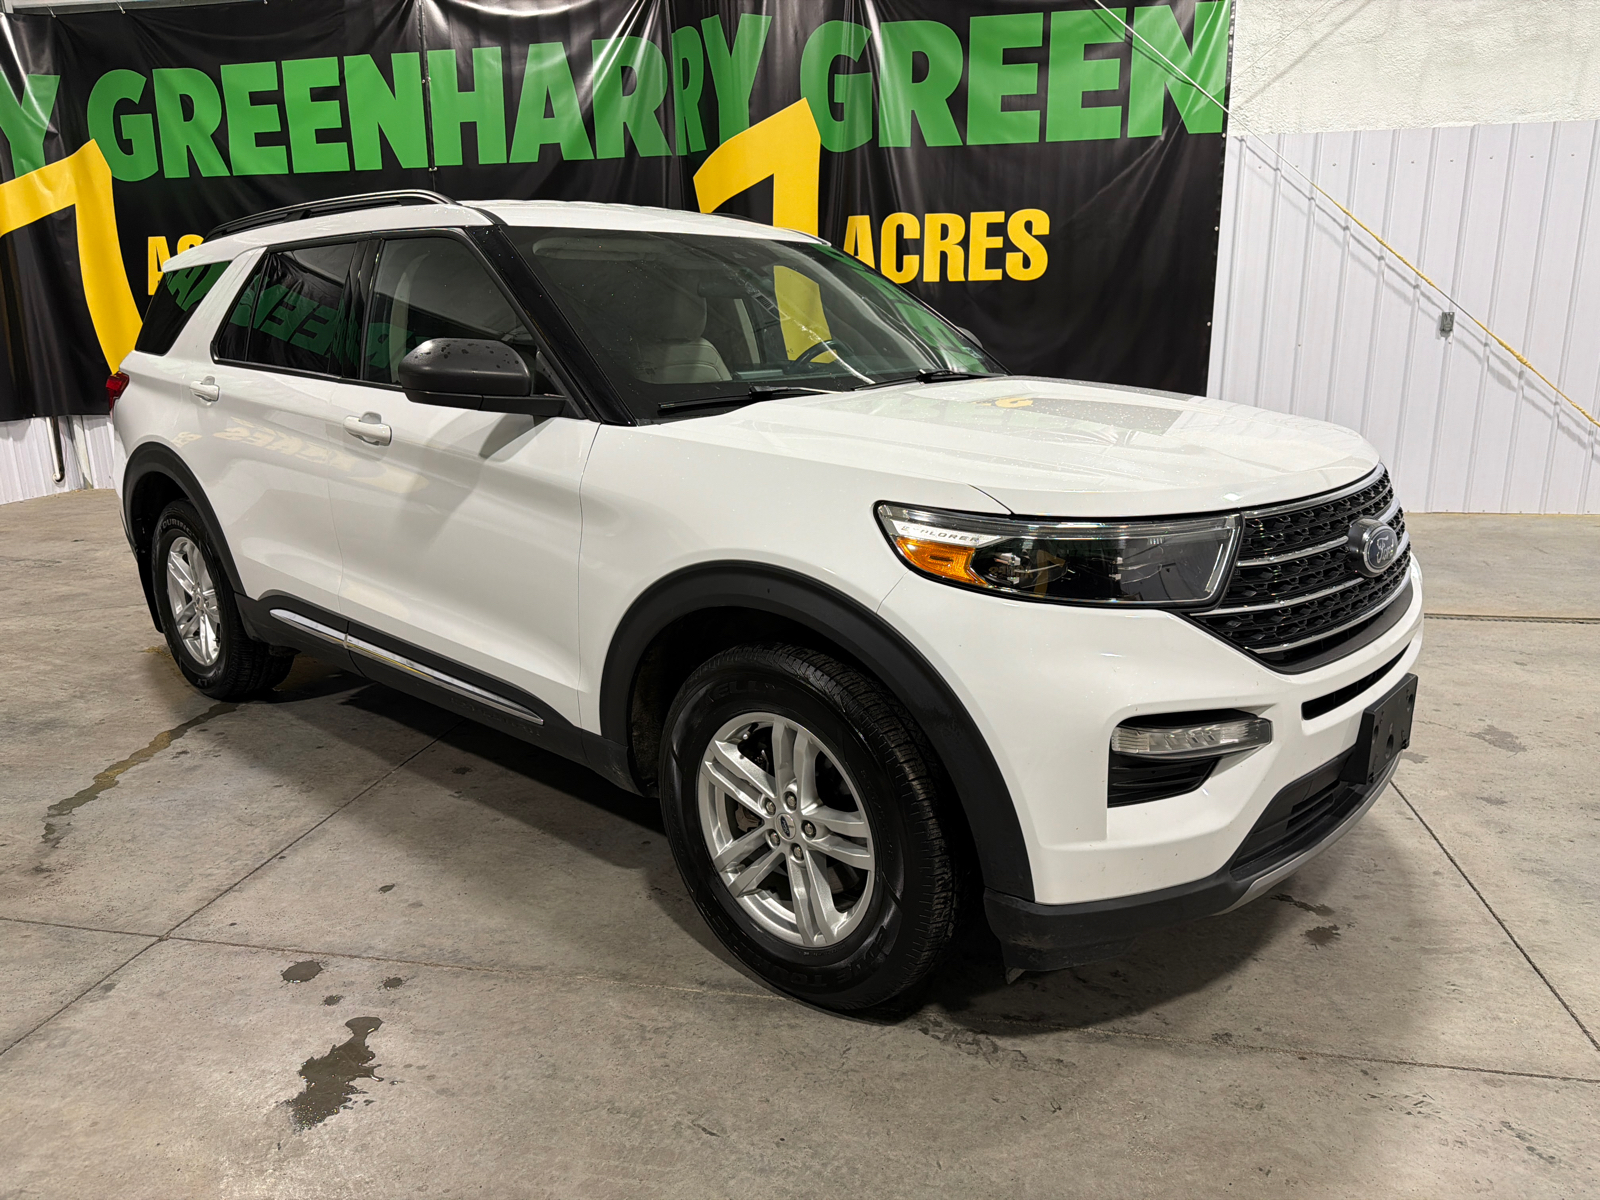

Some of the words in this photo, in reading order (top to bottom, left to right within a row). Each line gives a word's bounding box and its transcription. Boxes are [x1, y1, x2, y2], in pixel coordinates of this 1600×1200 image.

[87, 51, 432, 182] GREEN
[799, 0, 1231, 153] GREEN
[842, 208, 1051, 284] ACRES
